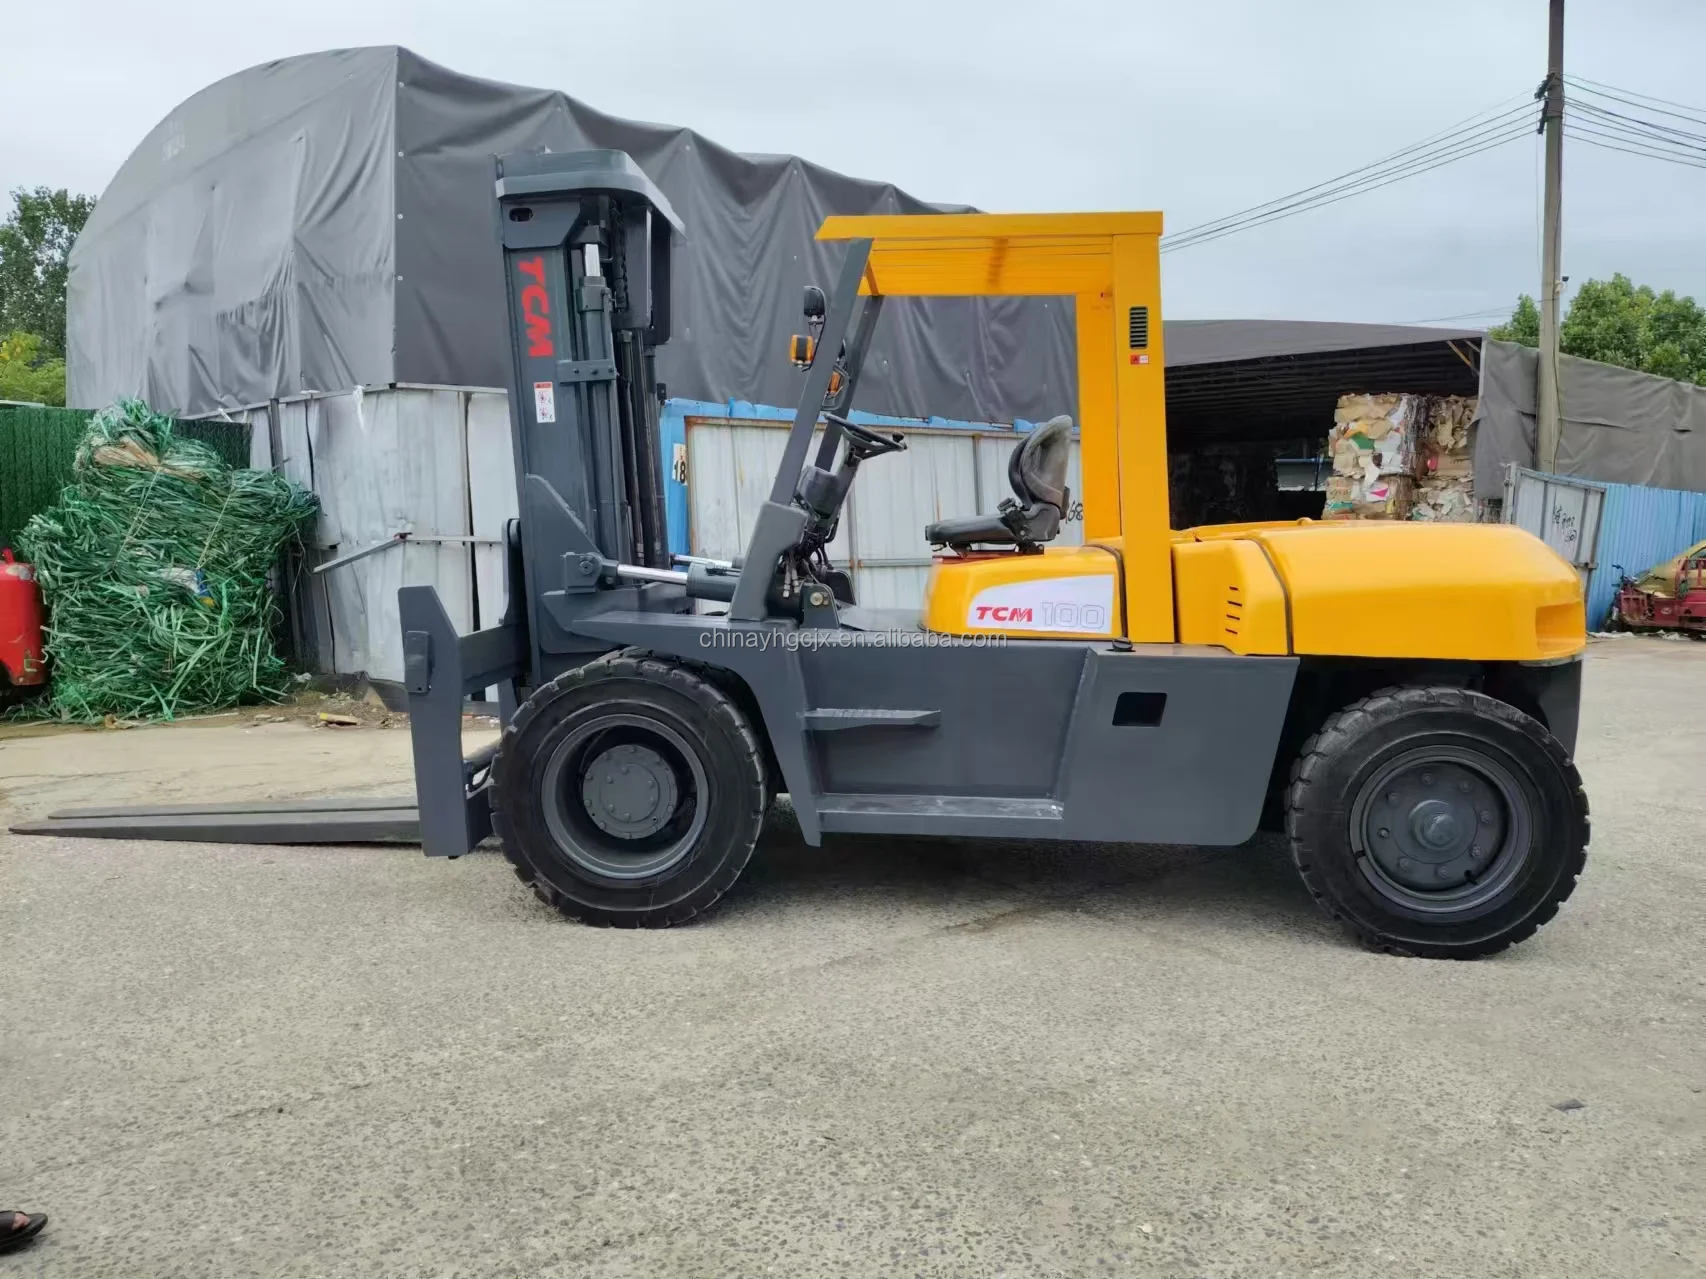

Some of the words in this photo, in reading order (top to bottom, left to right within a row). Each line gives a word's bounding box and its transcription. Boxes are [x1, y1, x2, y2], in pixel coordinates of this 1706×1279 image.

[518, 255, 554, 357] TCM
[976, 606, 1033, 622] TCM
[1040, 602, 1105, 629] 100
